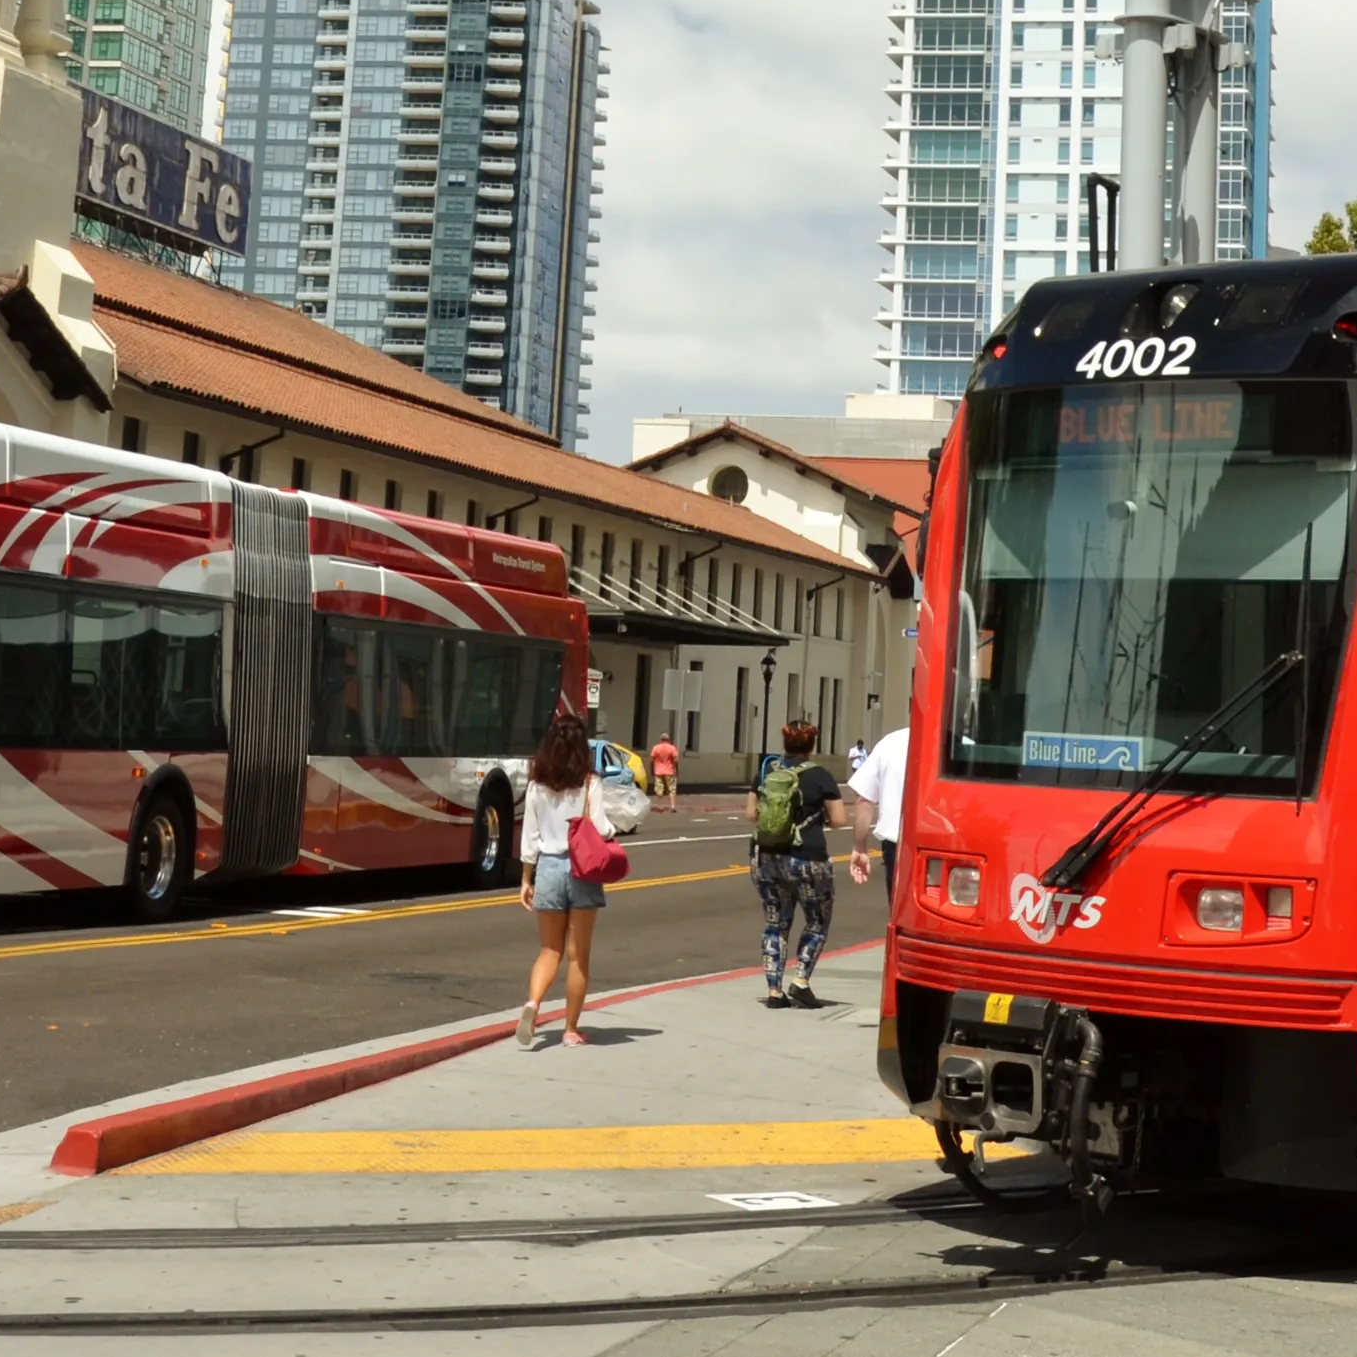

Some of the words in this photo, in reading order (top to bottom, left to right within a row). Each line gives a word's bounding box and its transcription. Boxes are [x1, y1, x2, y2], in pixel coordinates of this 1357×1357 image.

[178, 139, 241, 244] Fe
[1075, 336, 1197, 380] 4002
[1058, 404, 1136, 443] BLUE
[1154, 400, 1234, 441] LINE
[1029, 739, 1060, 762] Blue
[1064, 742, 1096, 764] Line
[1010, 891, 1106, 929] MTS
